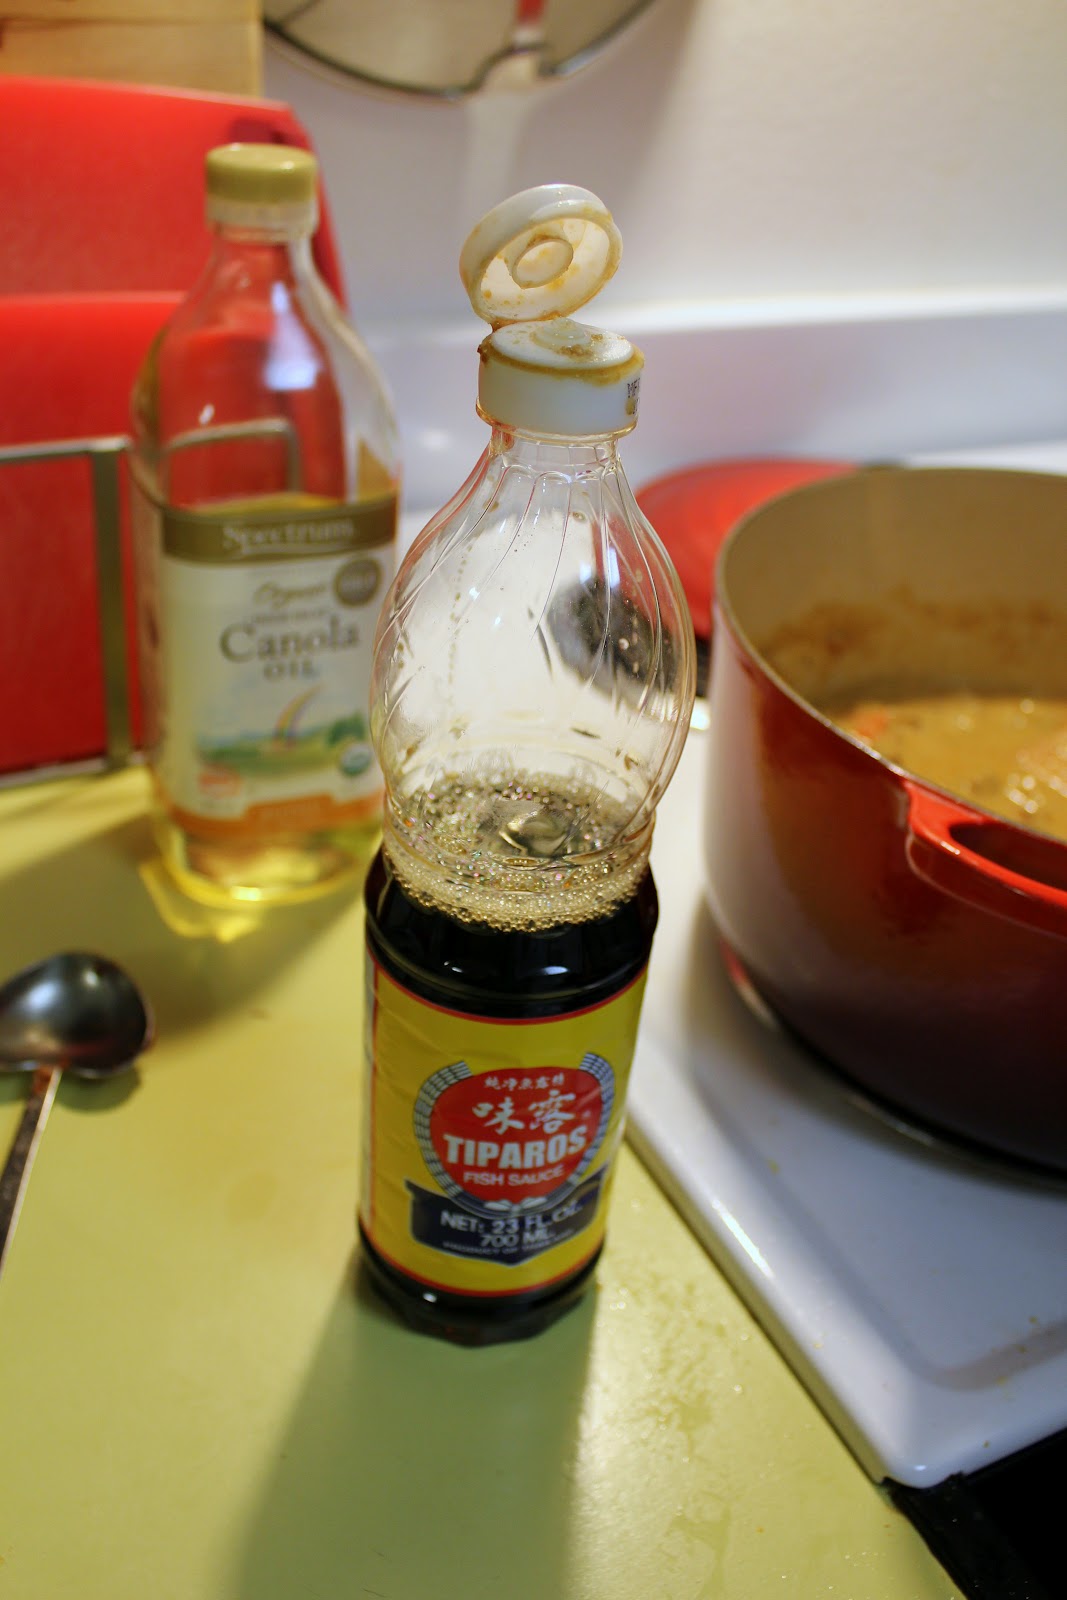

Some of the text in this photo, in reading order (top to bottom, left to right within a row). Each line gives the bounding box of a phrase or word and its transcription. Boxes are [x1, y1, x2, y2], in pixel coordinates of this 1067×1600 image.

[219, 614, 360, 663] Canola
[443, 1125, 588, 1169] TIPAROS
[463, 1164, 565, 1186] FISH SAUCE
[491, 1217, 519, 1234] 23
[481, 1233, 519, 1248] 700
